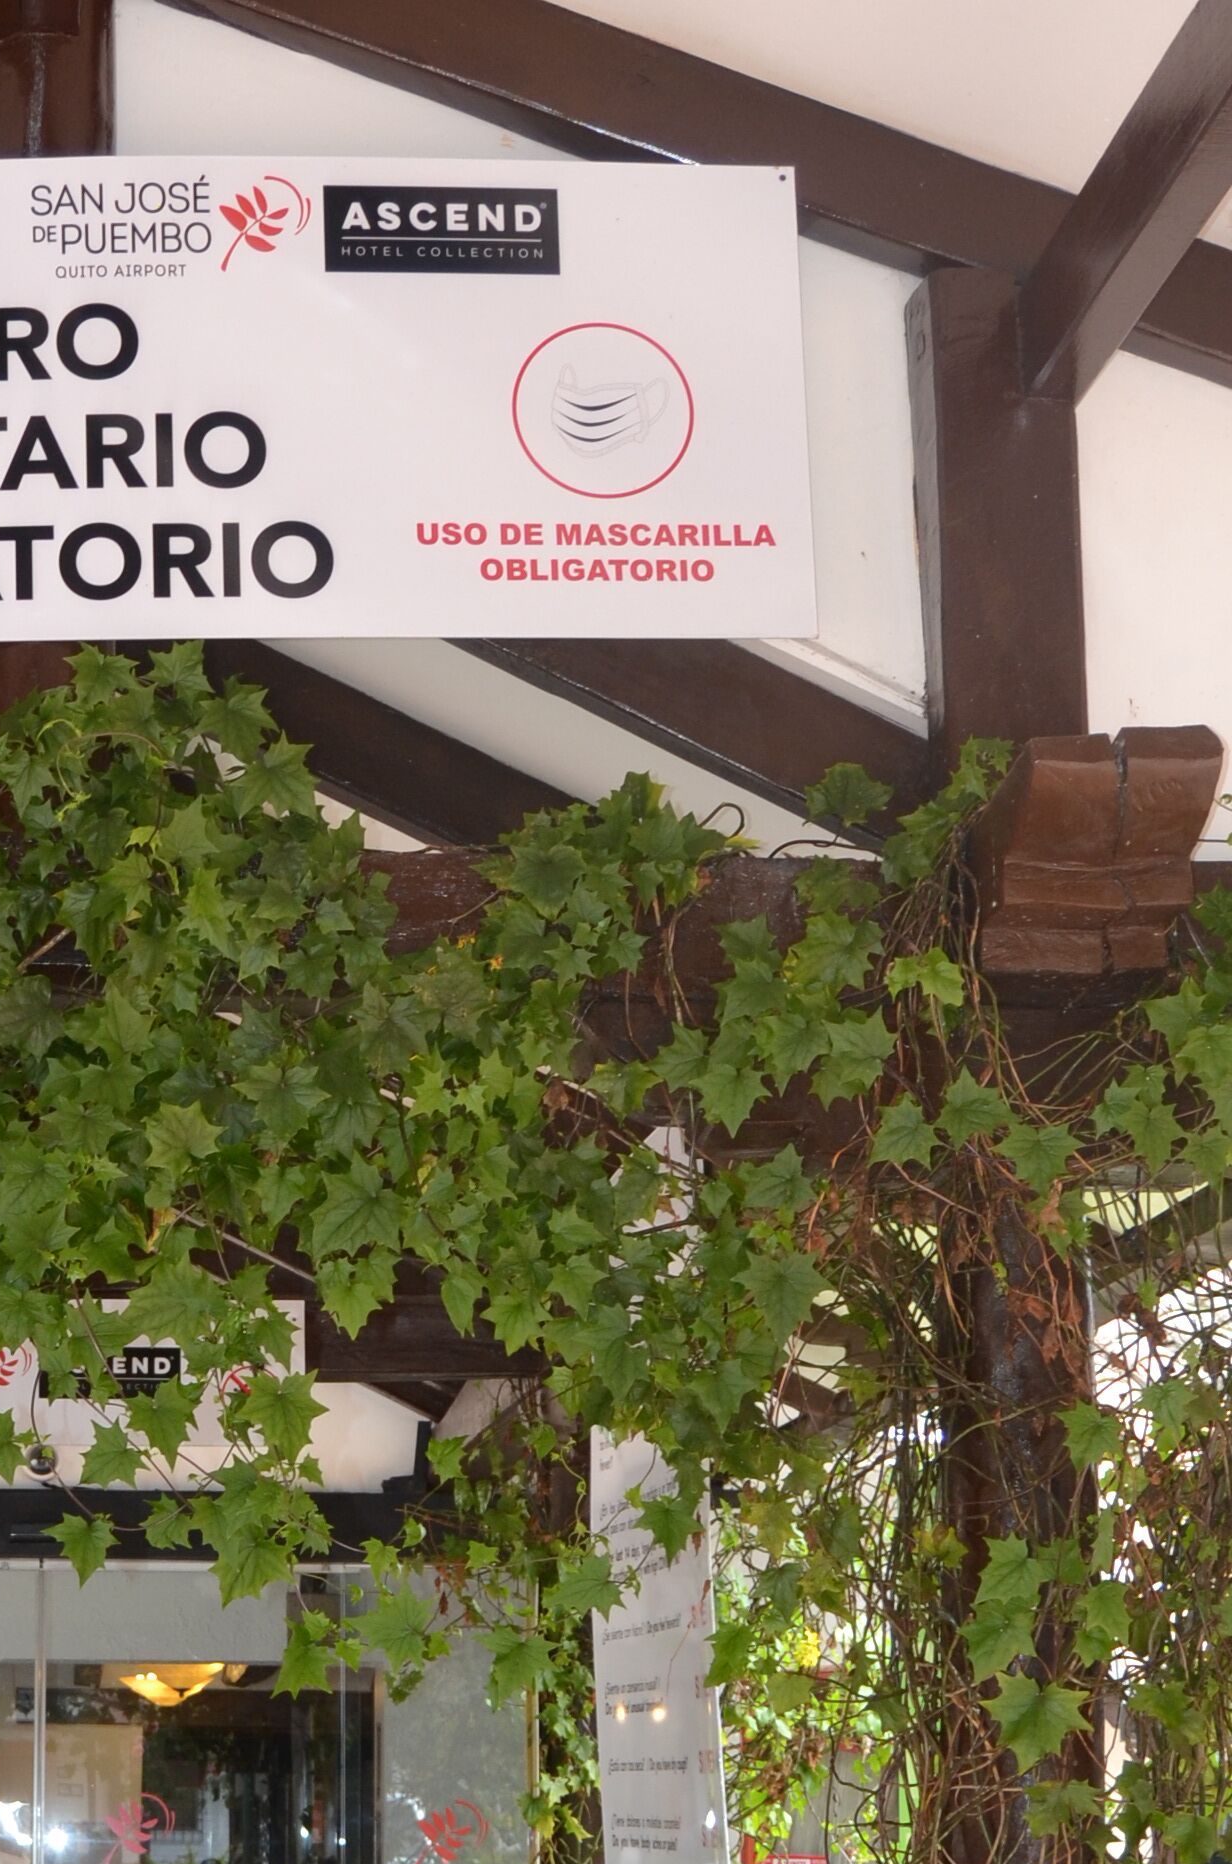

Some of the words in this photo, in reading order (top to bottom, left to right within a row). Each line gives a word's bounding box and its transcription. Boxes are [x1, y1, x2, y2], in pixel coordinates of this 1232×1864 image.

[30, 186, 107, 216] SAN
[115, 175, 211, 215] JOSÉ
[342, 201, 542, 233] ASCEND
[32, 224, 57, 244] DE
[60, 221, 213, 256] PUEMBO
[341, 245, 404, 258] HOTEL
[416, 246, 545, 260] COLLECTION
[55, 263, 108, 280] QUITO
[113, 262, 187, 279] AIRPORT
[416, 523, 488, 547] USO
[500, 523, 545, 547] DE
[554, 523, 777, 548] MASCARILLA
[480, 557, 716, 583] OBLIGATORIO
